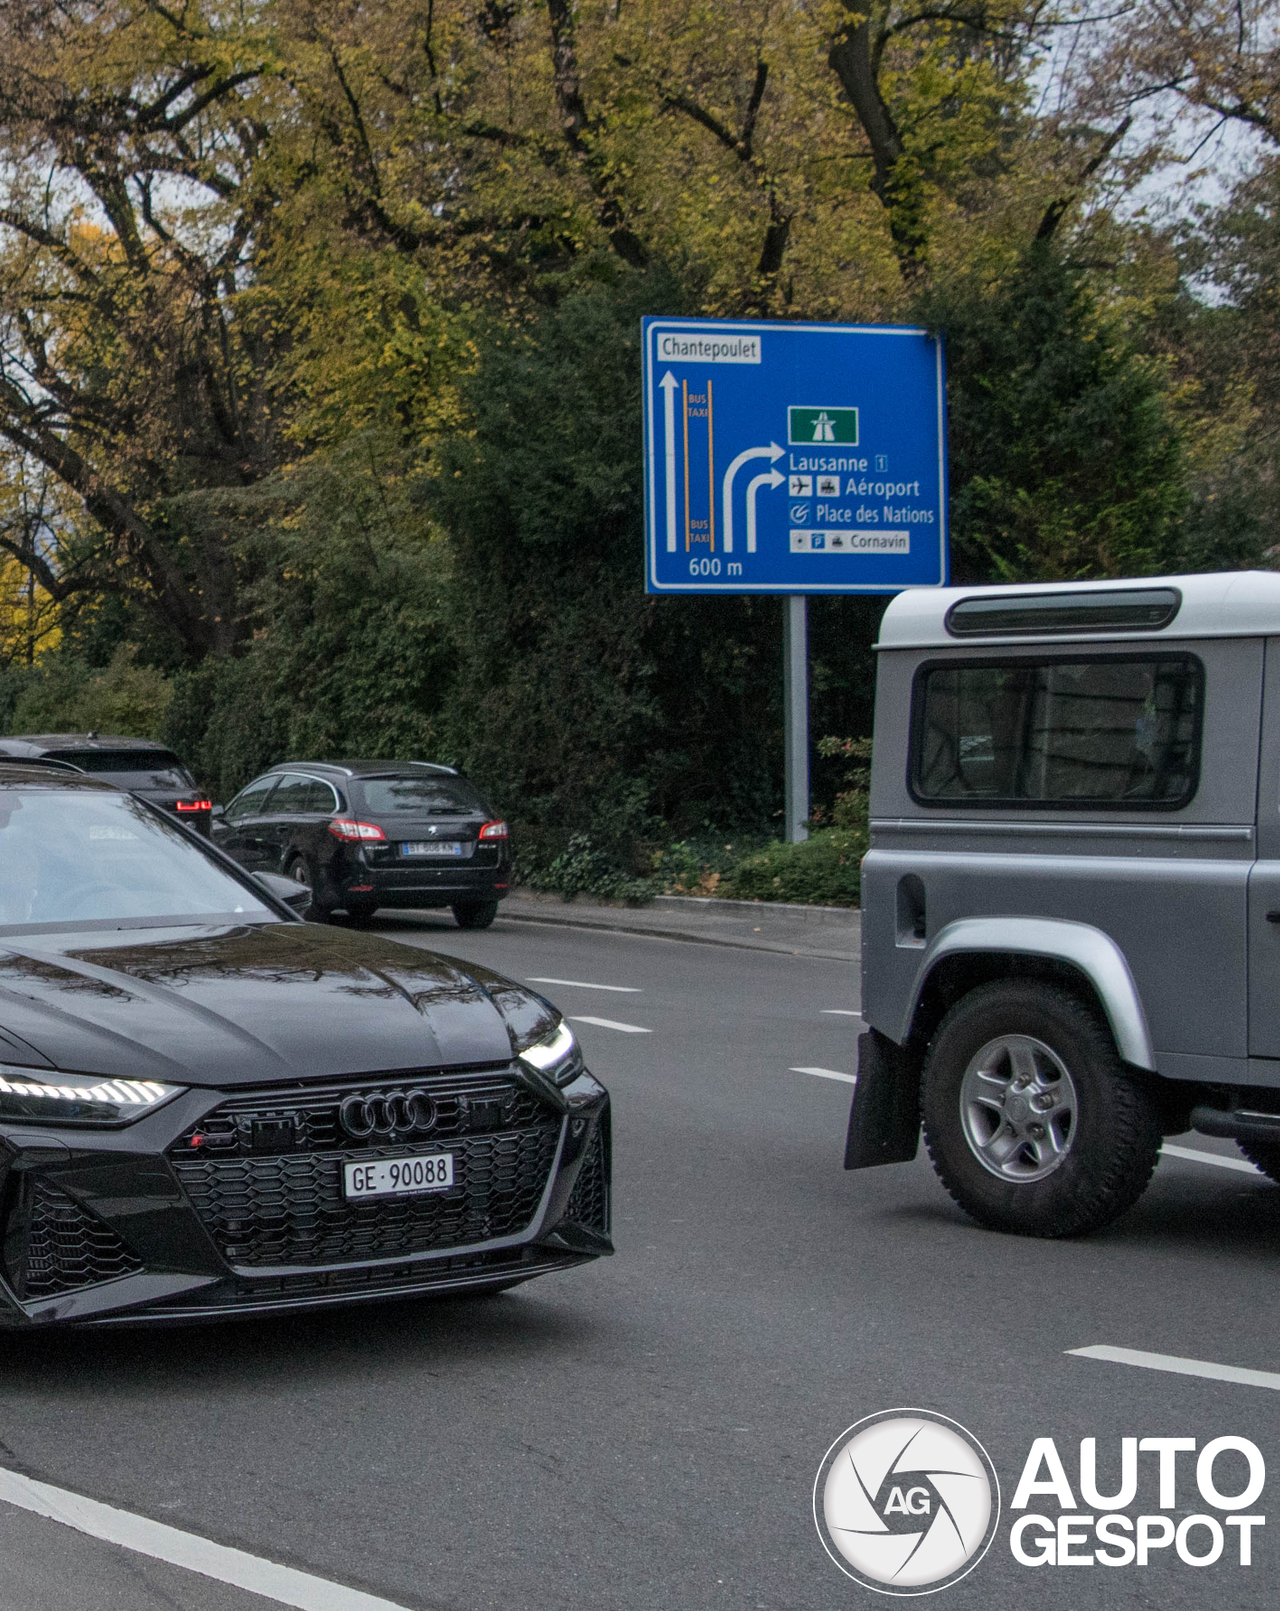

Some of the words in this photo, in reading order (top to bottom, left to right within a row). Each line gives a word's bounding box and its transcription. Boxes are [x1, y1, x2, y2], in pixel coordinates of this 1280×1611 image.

[662, 337, 756, 361] Chantepoulet
[688, 393, 707, 404] BUS
[688, 407, 709, 418] TAXI
[789, 452, 868, 472] Lausanne
[845, 477, 920, 500] Aéroport
[816, 503, 852, 522] Place
[856, 504, 879, 522] des
[883, 505, 934, 523] Nations
[690, 519, 708, 530] BUS
[690, 533, 710, 543] TAXI
[850, 534, 907, 549] Cornavin
[689, 557, 721, 576] 600
[727, 562, 742, 576] m
